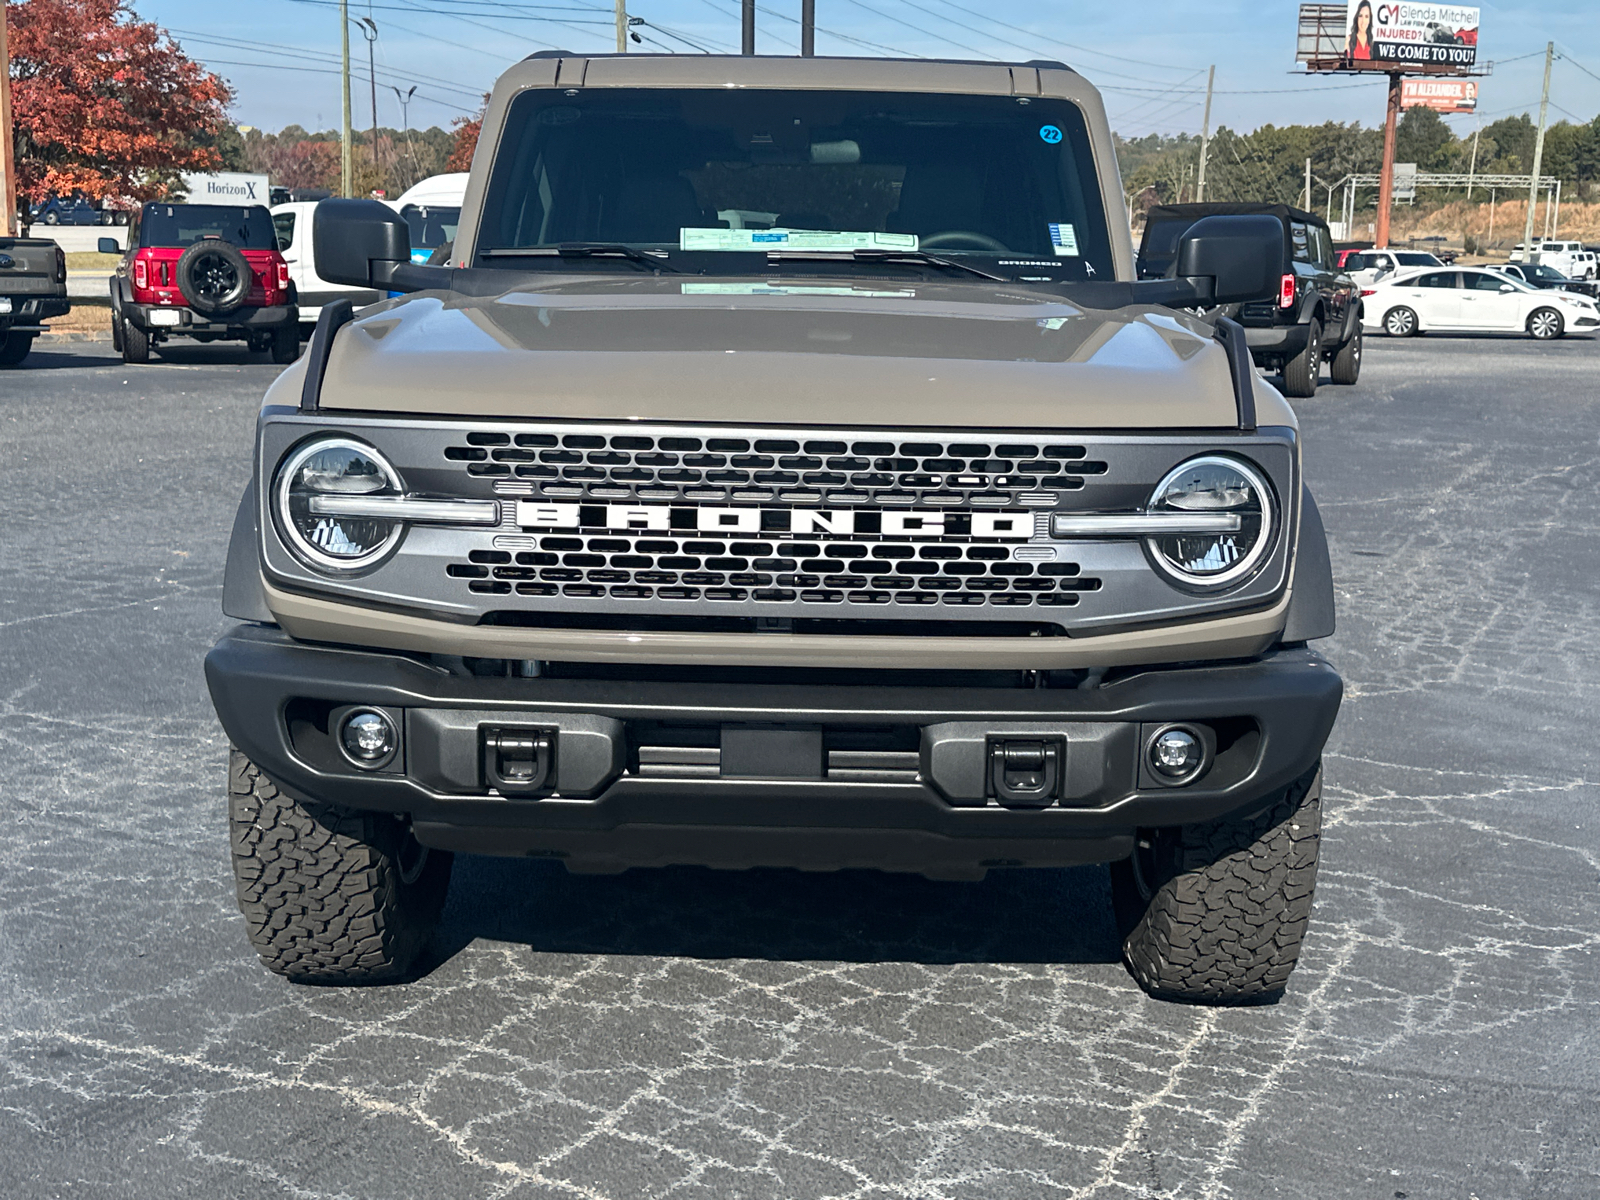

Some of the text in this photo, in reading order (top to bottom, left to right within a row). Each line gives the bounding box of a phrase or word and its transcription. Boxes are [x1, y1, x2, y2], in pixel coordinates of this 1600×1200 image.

[1400, 5, 1478, 24] Glenda Mitchell
[1376, 28, 1422, 40] INJURED?
[1378, 44, 1475, 63] WE COME TO YOU!
[1043, 129, 1059, 141] 22
[516, 501, 1034, 538] BRONCO
